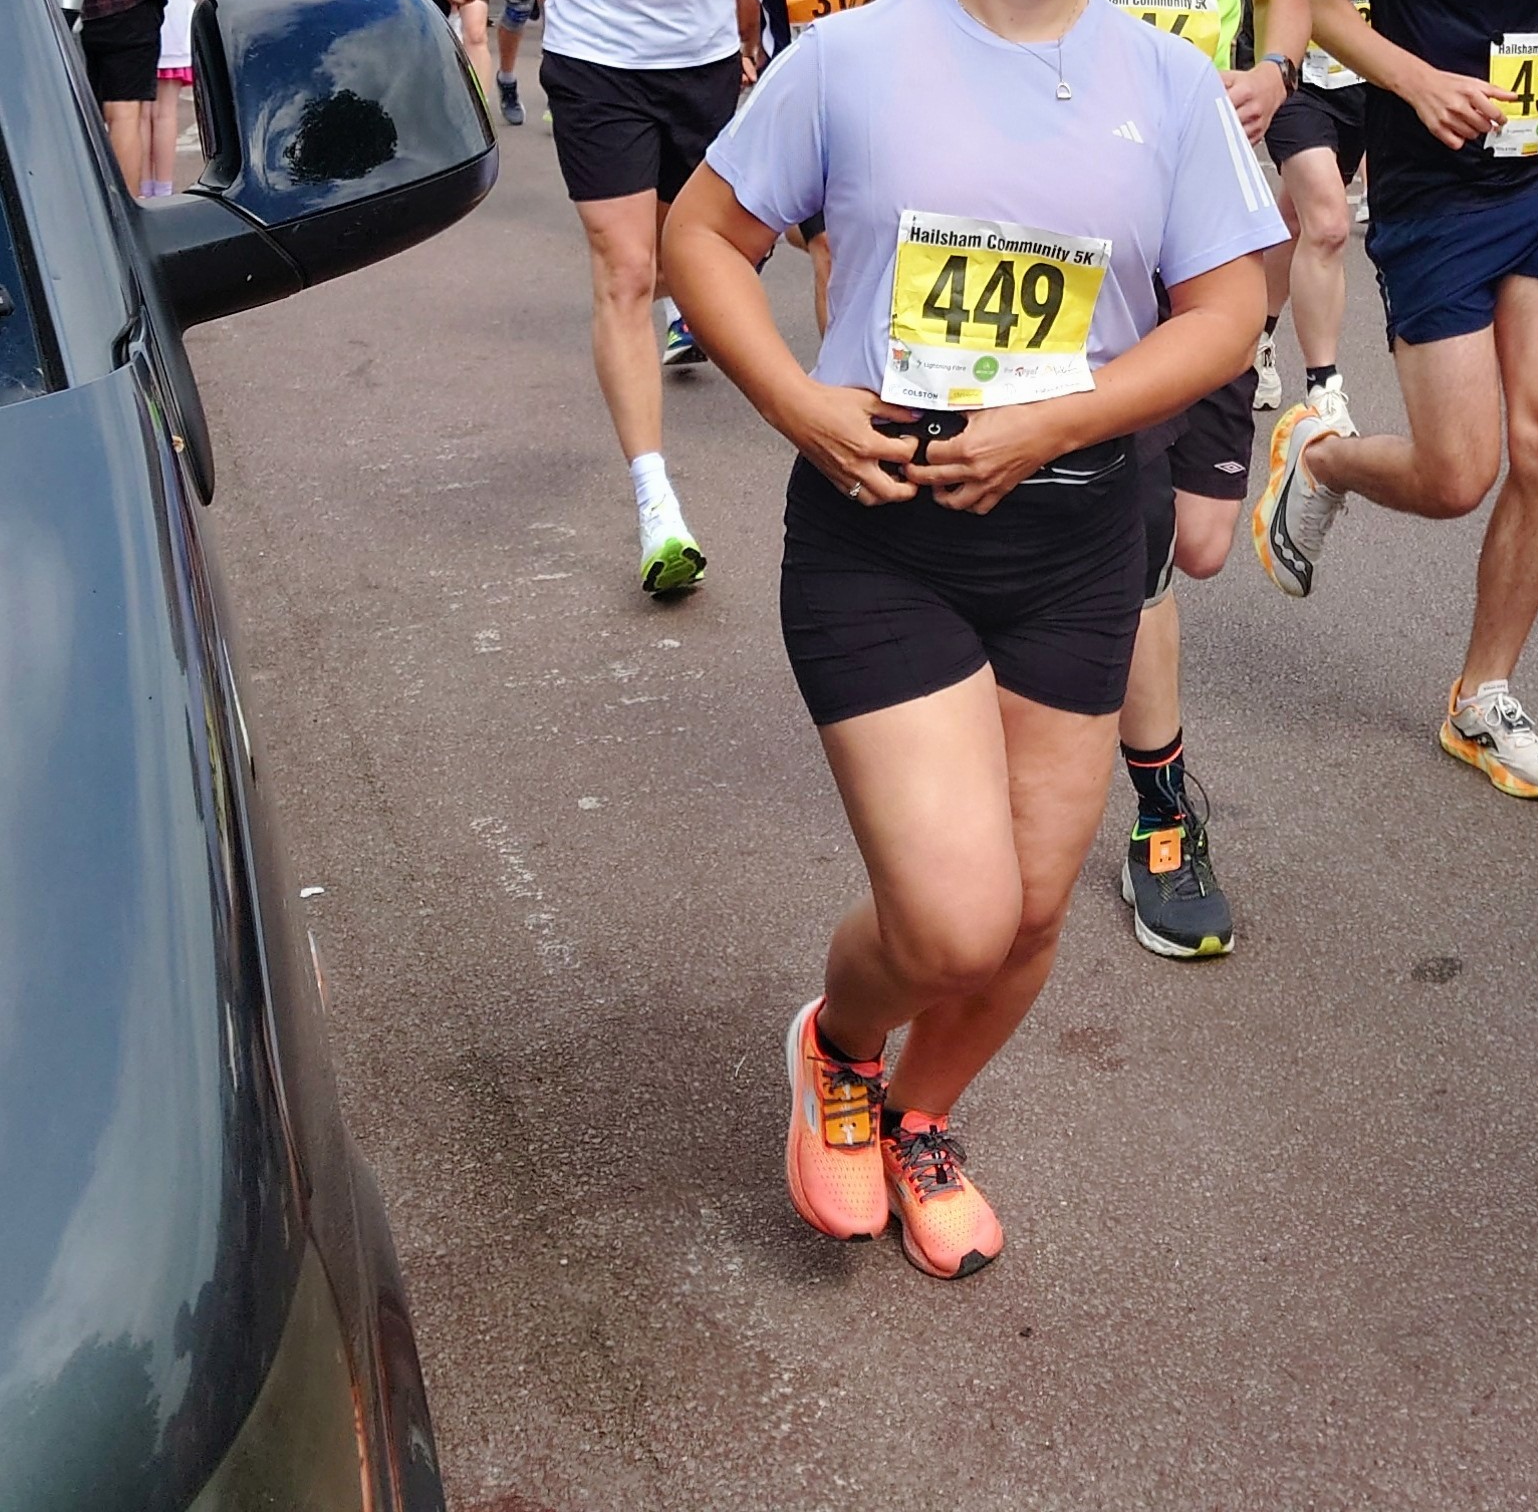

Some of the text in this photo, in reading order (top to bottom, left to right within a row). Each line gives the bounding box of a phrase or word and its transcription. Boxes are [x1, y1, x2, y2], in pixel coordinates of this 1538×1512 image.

[909, 226, 1096, 266] Hailsham Community 5K
[921, 254, 1066, 349] 449
[902, 388, 939, 400] COLSTON
